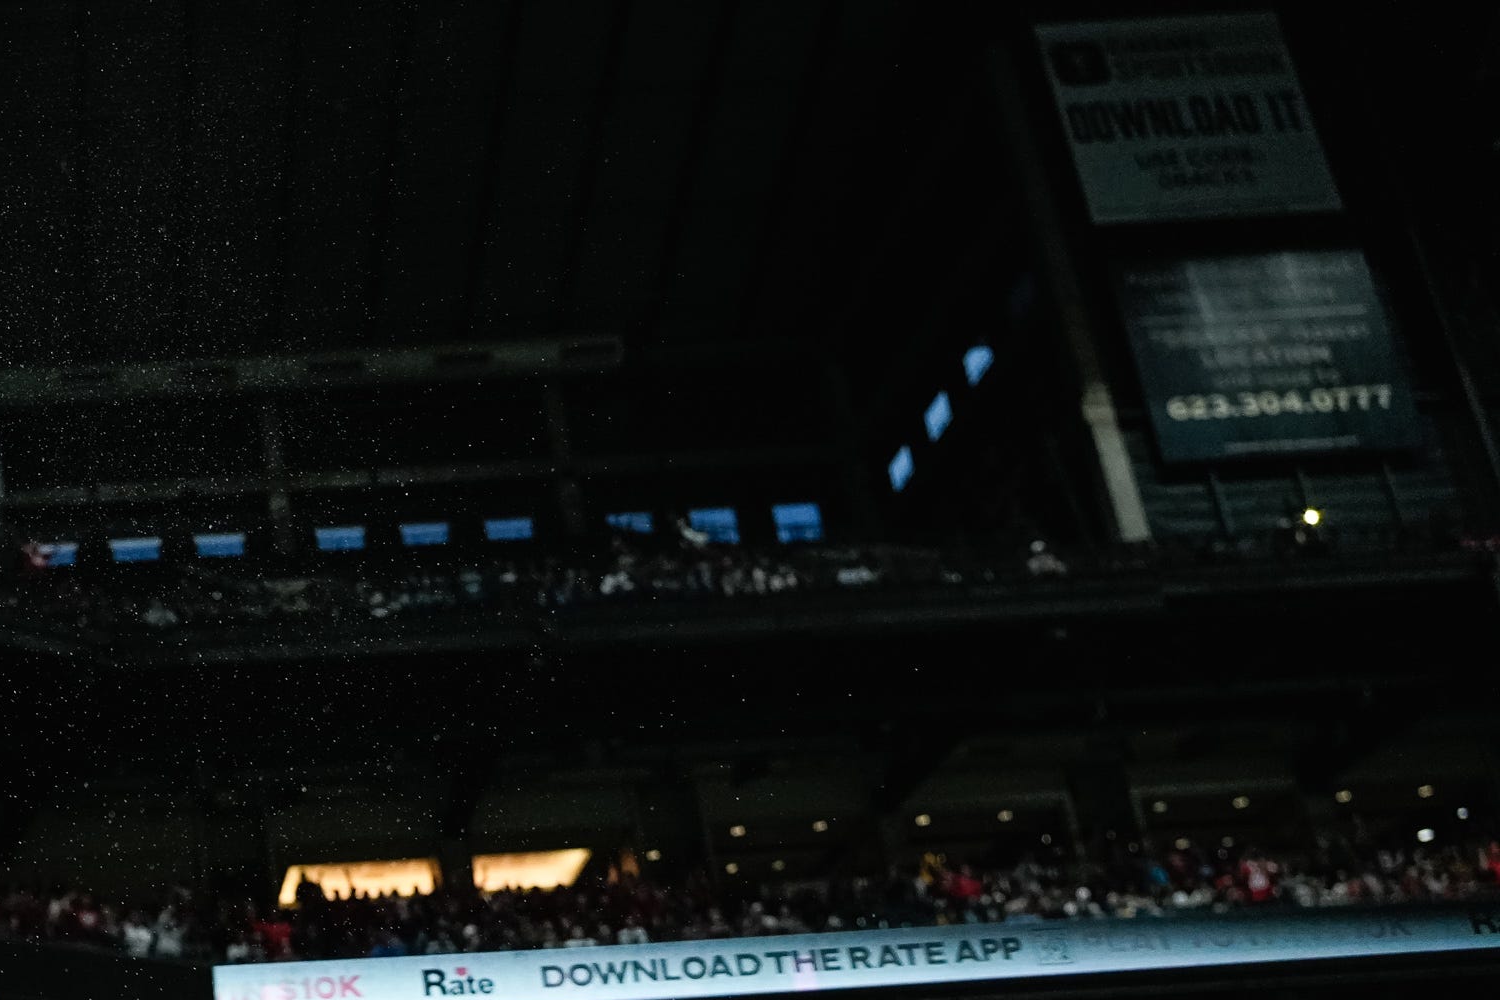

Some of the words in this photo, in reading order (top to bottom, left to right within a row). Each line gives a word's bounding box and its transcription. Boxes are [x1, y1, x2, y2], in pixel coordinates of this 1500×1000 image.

[1066, 93, 1260, 142] DOWNLOAD
[1265, 89, 1303, 132] IT
[1166, 384, 1391, 421] 623.304.0777
[541, 951, 762, 989] DOWNLOAD
[764, 946, 841, 973] THE
[850, 941, 948, 969] RATE
[955, 936, 1022, 963] APP
[277, 974, 364, 1000] $10K
[421, 967, 495, 997] Rate
